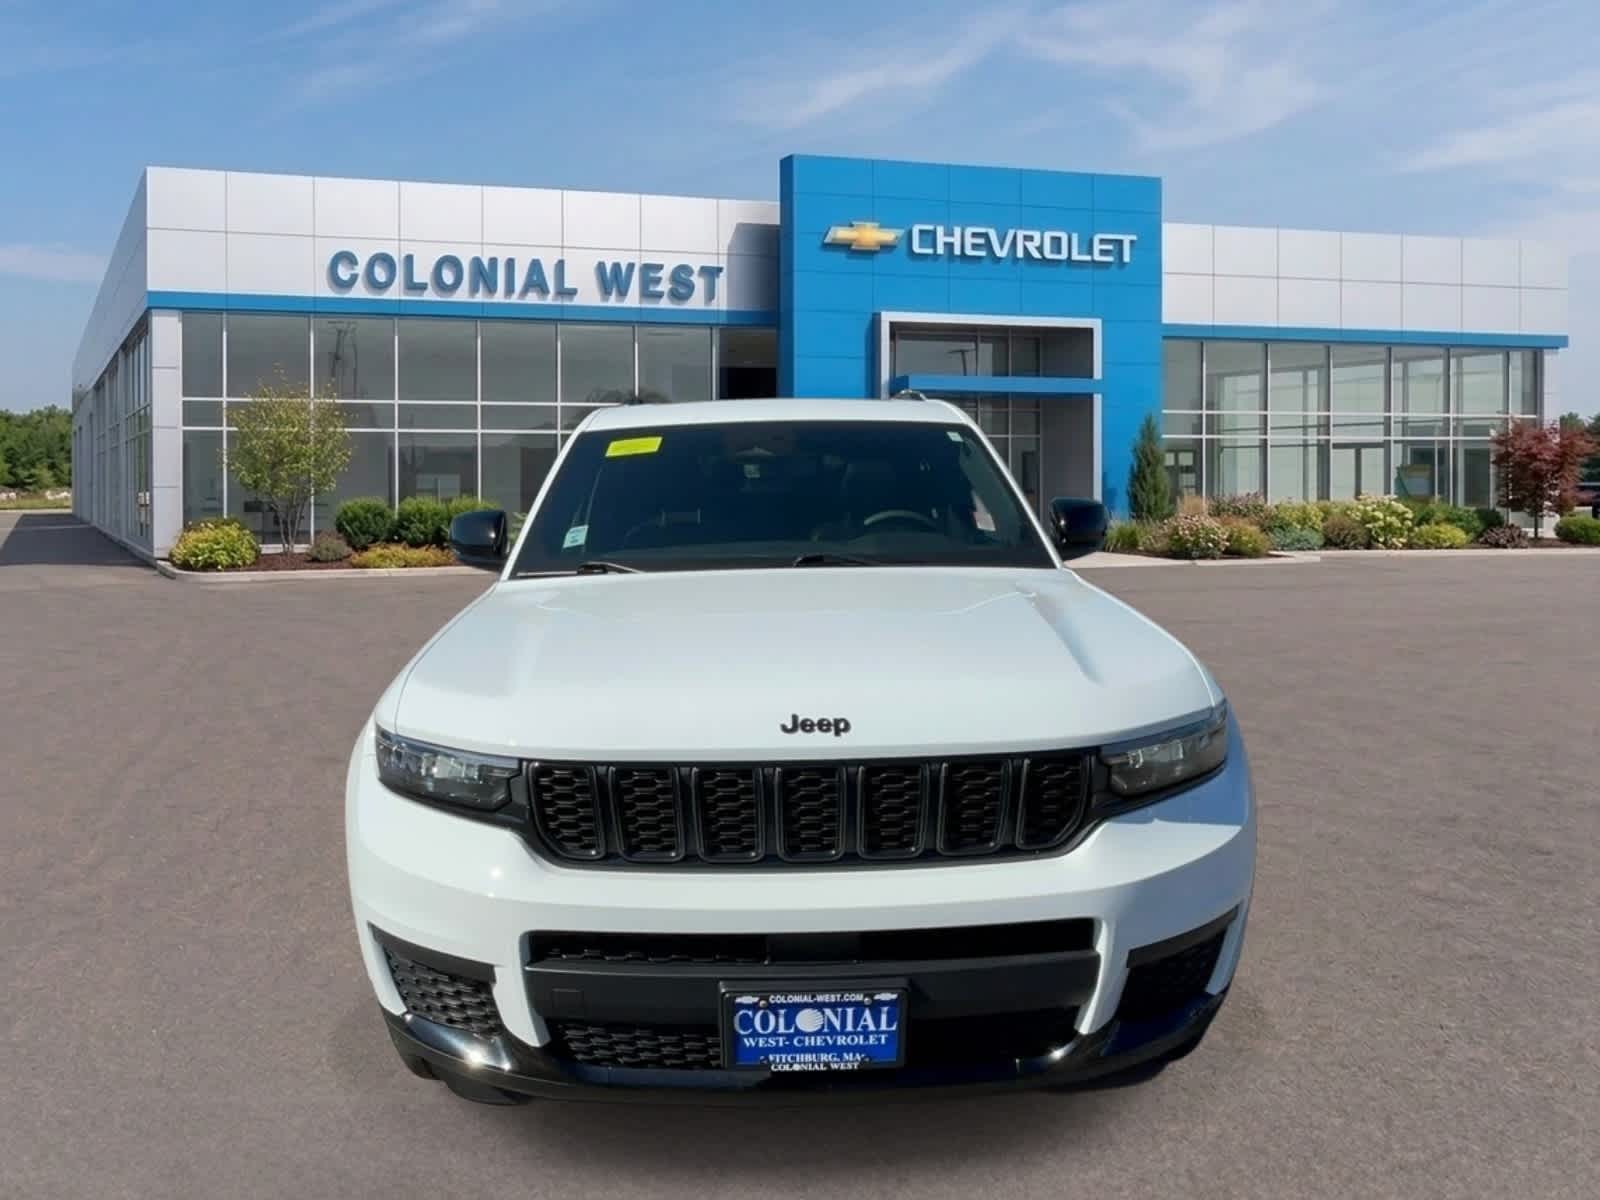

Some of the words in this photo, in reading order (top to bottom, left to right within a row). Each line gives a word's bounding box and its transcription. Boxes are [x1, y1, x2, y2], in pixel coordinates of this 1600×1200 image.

[911, 223, 1138, 263] CHEVROLET
[328, 250, 578, 297] COLONIAL
[595, 260, 724, 303] WEST
[780, 713, 851, 737] Jeep
[769, 993, 864, 1004] COLONIAL-WEST.COM
[733, 1006, 898, 1035] COLONIAL
[793, 1034, 888, 1047] CHEVROLET
[770, 1062, 828, 1072] COLONIAL
[830, 1061, 860, 1071] WEST
